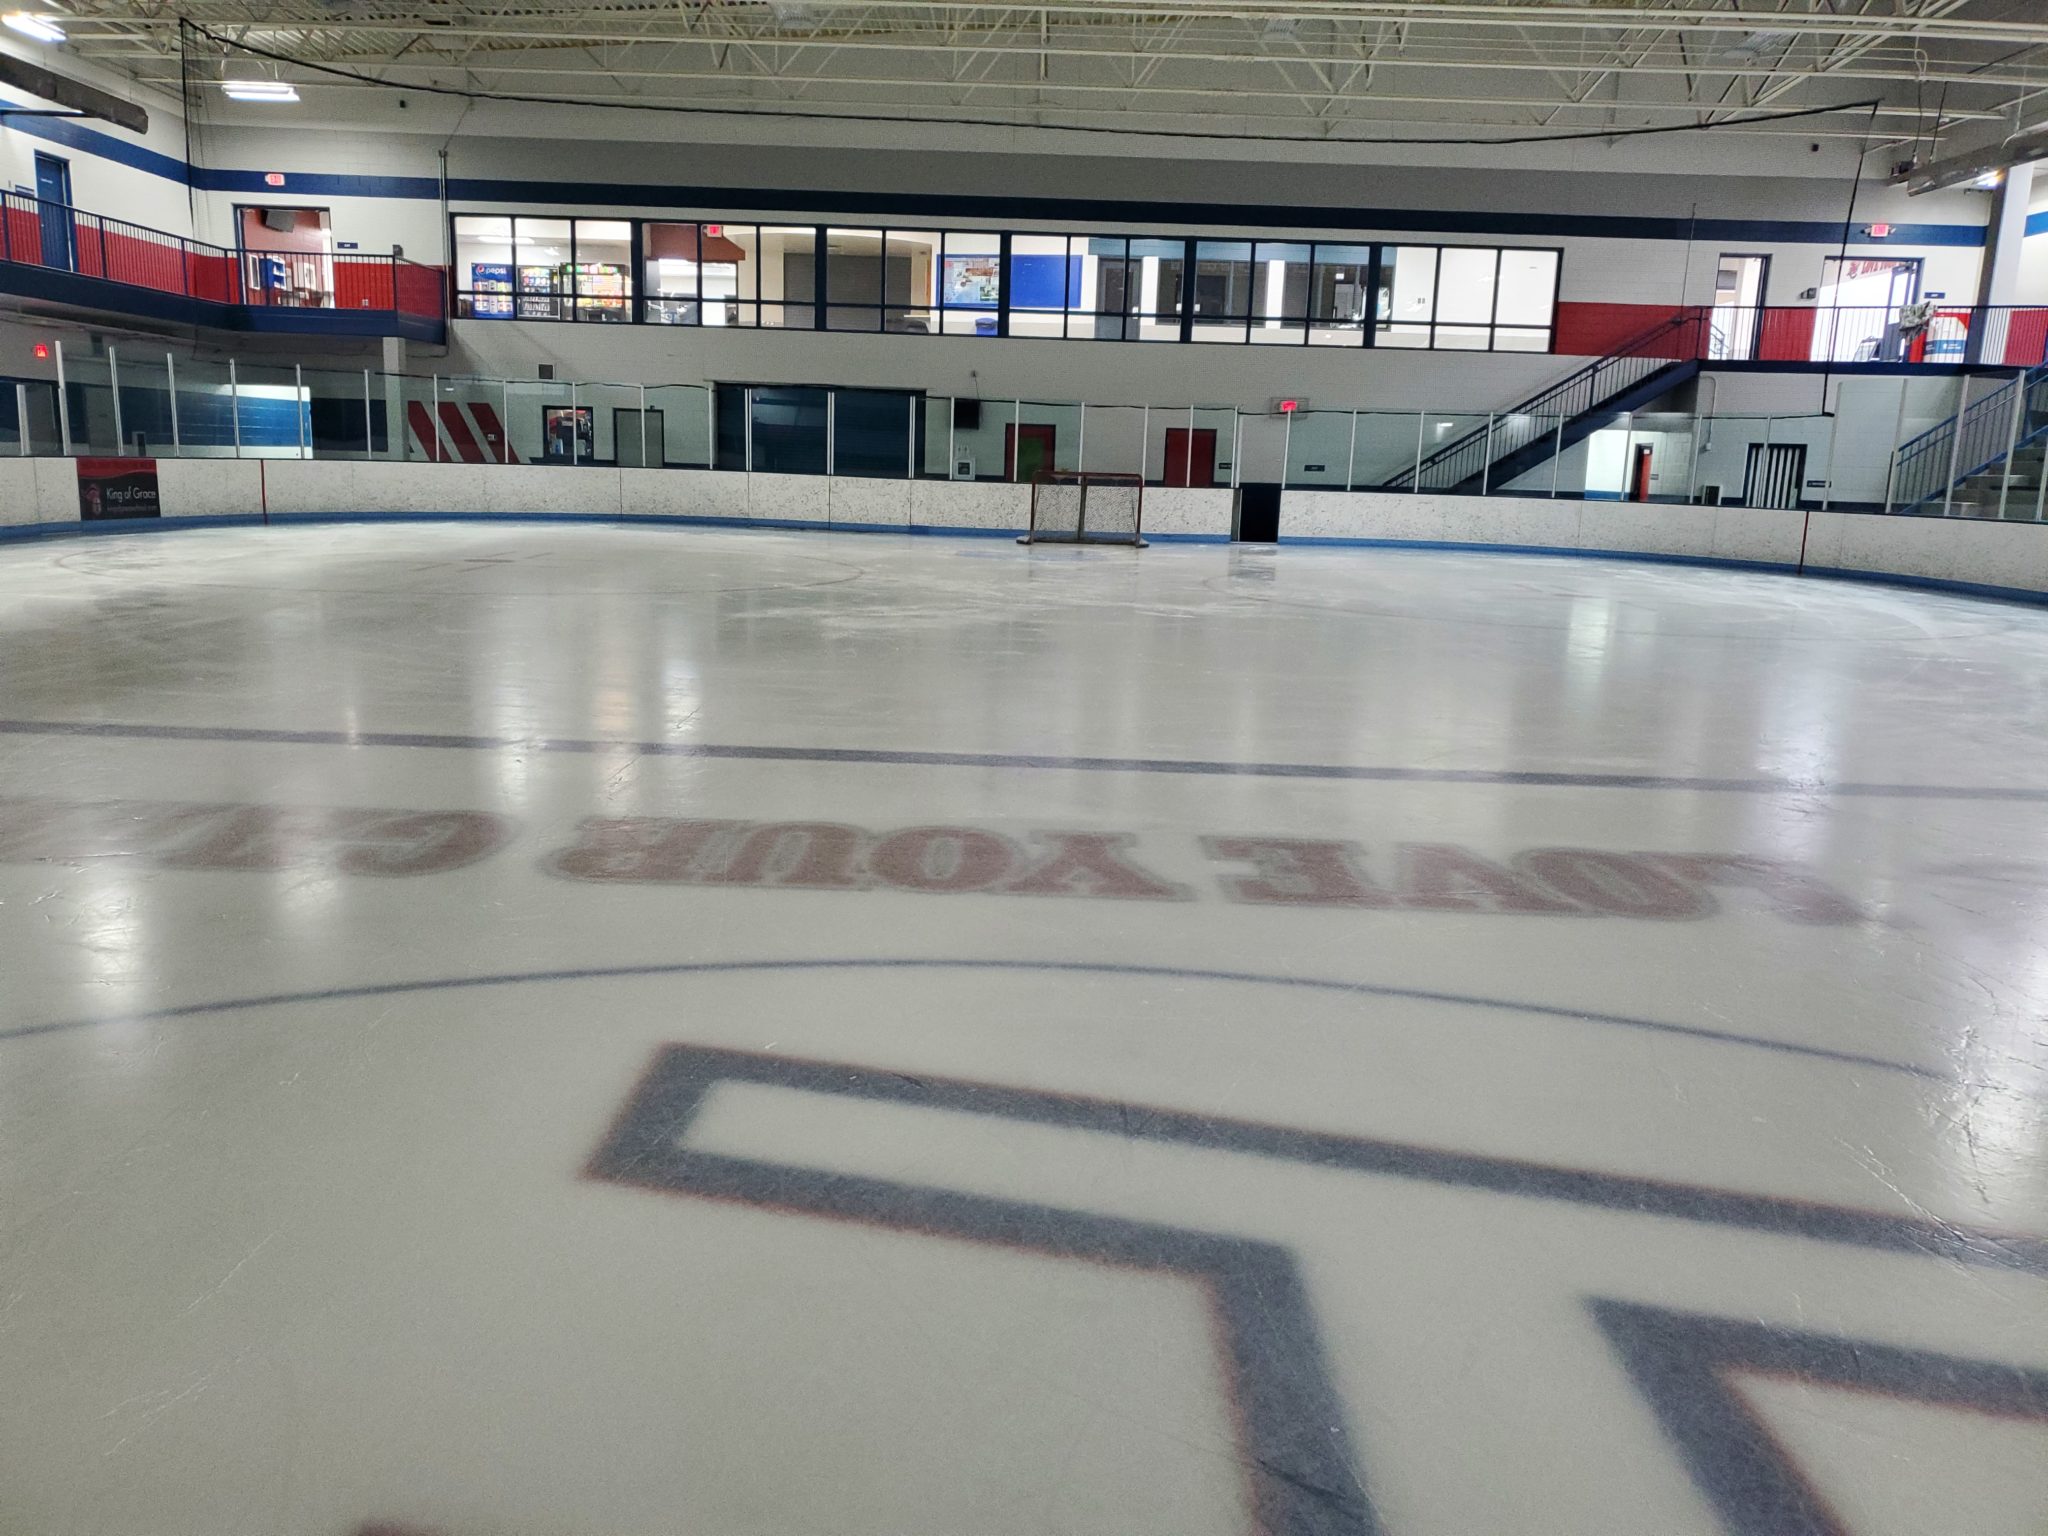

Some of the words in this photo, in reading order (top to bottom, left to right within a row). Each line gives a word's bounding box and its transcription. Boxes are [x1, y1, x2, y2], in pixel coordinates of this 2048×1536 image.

[486, 266, 507, 275] pepsi
[106, 488, 123, 503] King
[124, 486, 132, 499] of
[133, 487, 156, 499] Grace
[537, 817, 1192, 901] YOUR
